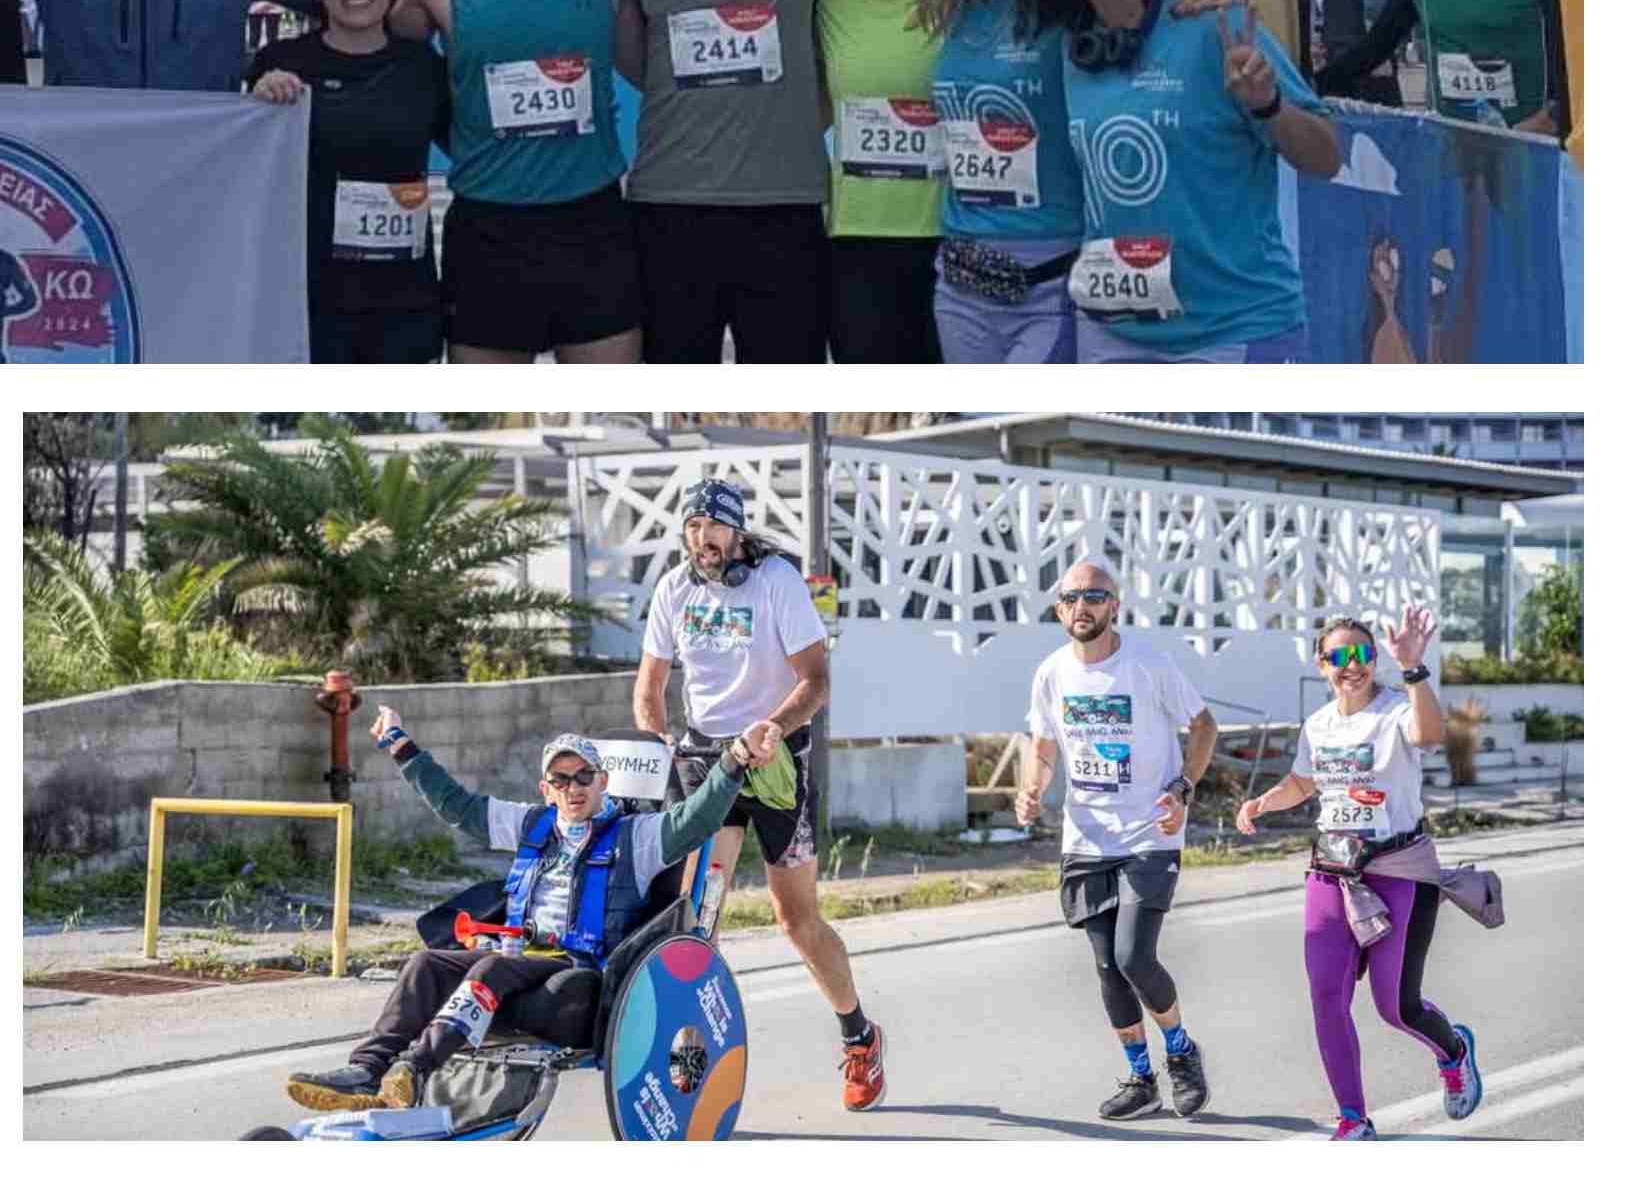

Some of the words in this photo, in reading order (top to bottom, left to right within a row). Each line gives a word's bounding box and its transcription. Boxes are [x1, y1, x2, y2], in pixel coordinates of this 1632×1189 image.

[692, 34, 759, 63] 2414
[1013, 78, 1043, 96] TH
[511, 87, 576, 115] 2430
[1153, 109, 1180, 127] TH
[861, 128, 926, 153] 2320
[954, 152, 1013, 179] 2647
[358, 214, 414, 236] 1201
[1089, 272, 1149, 298] 2640
